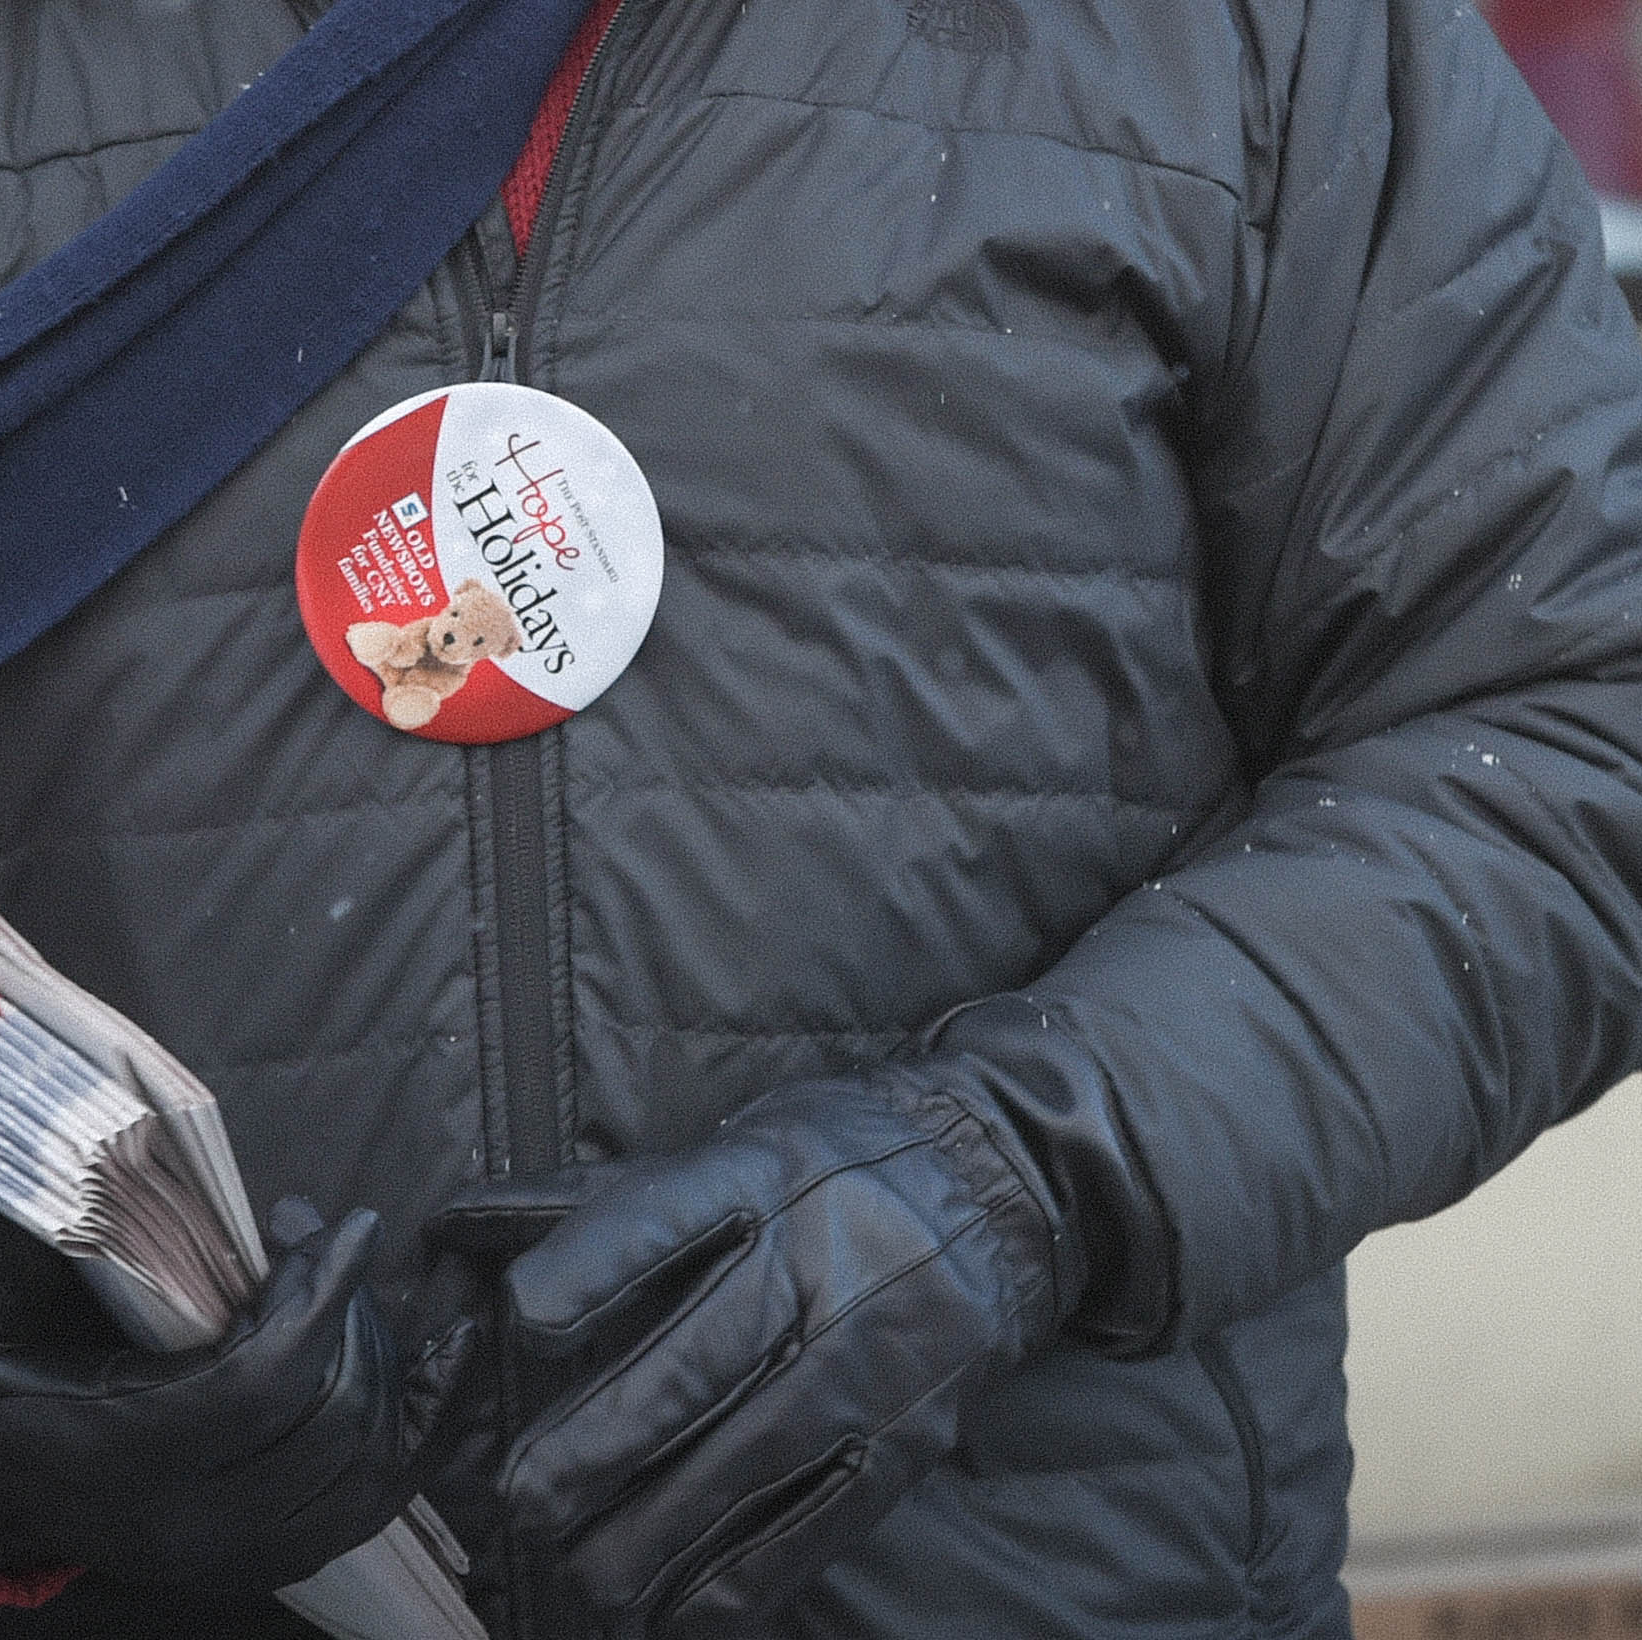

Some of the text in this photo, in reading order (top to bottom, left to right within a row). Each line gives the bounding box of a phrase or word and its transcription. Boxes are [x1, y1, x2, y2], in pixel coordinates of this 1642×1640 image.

[446, 469, 466, 493] the
[461, 460, 480, 483] for
[495, 433, 580, 571] Hope
[350, 544, 398, 607] for CNY
[362, 528, 413, 607] Fundraiser
[373, 509, 436, 607] NEWSBOYS
[406, 529, 437, 570] OLD
[456, 480, 576, 675] Holidays
[337, 557, 375, 614] families
